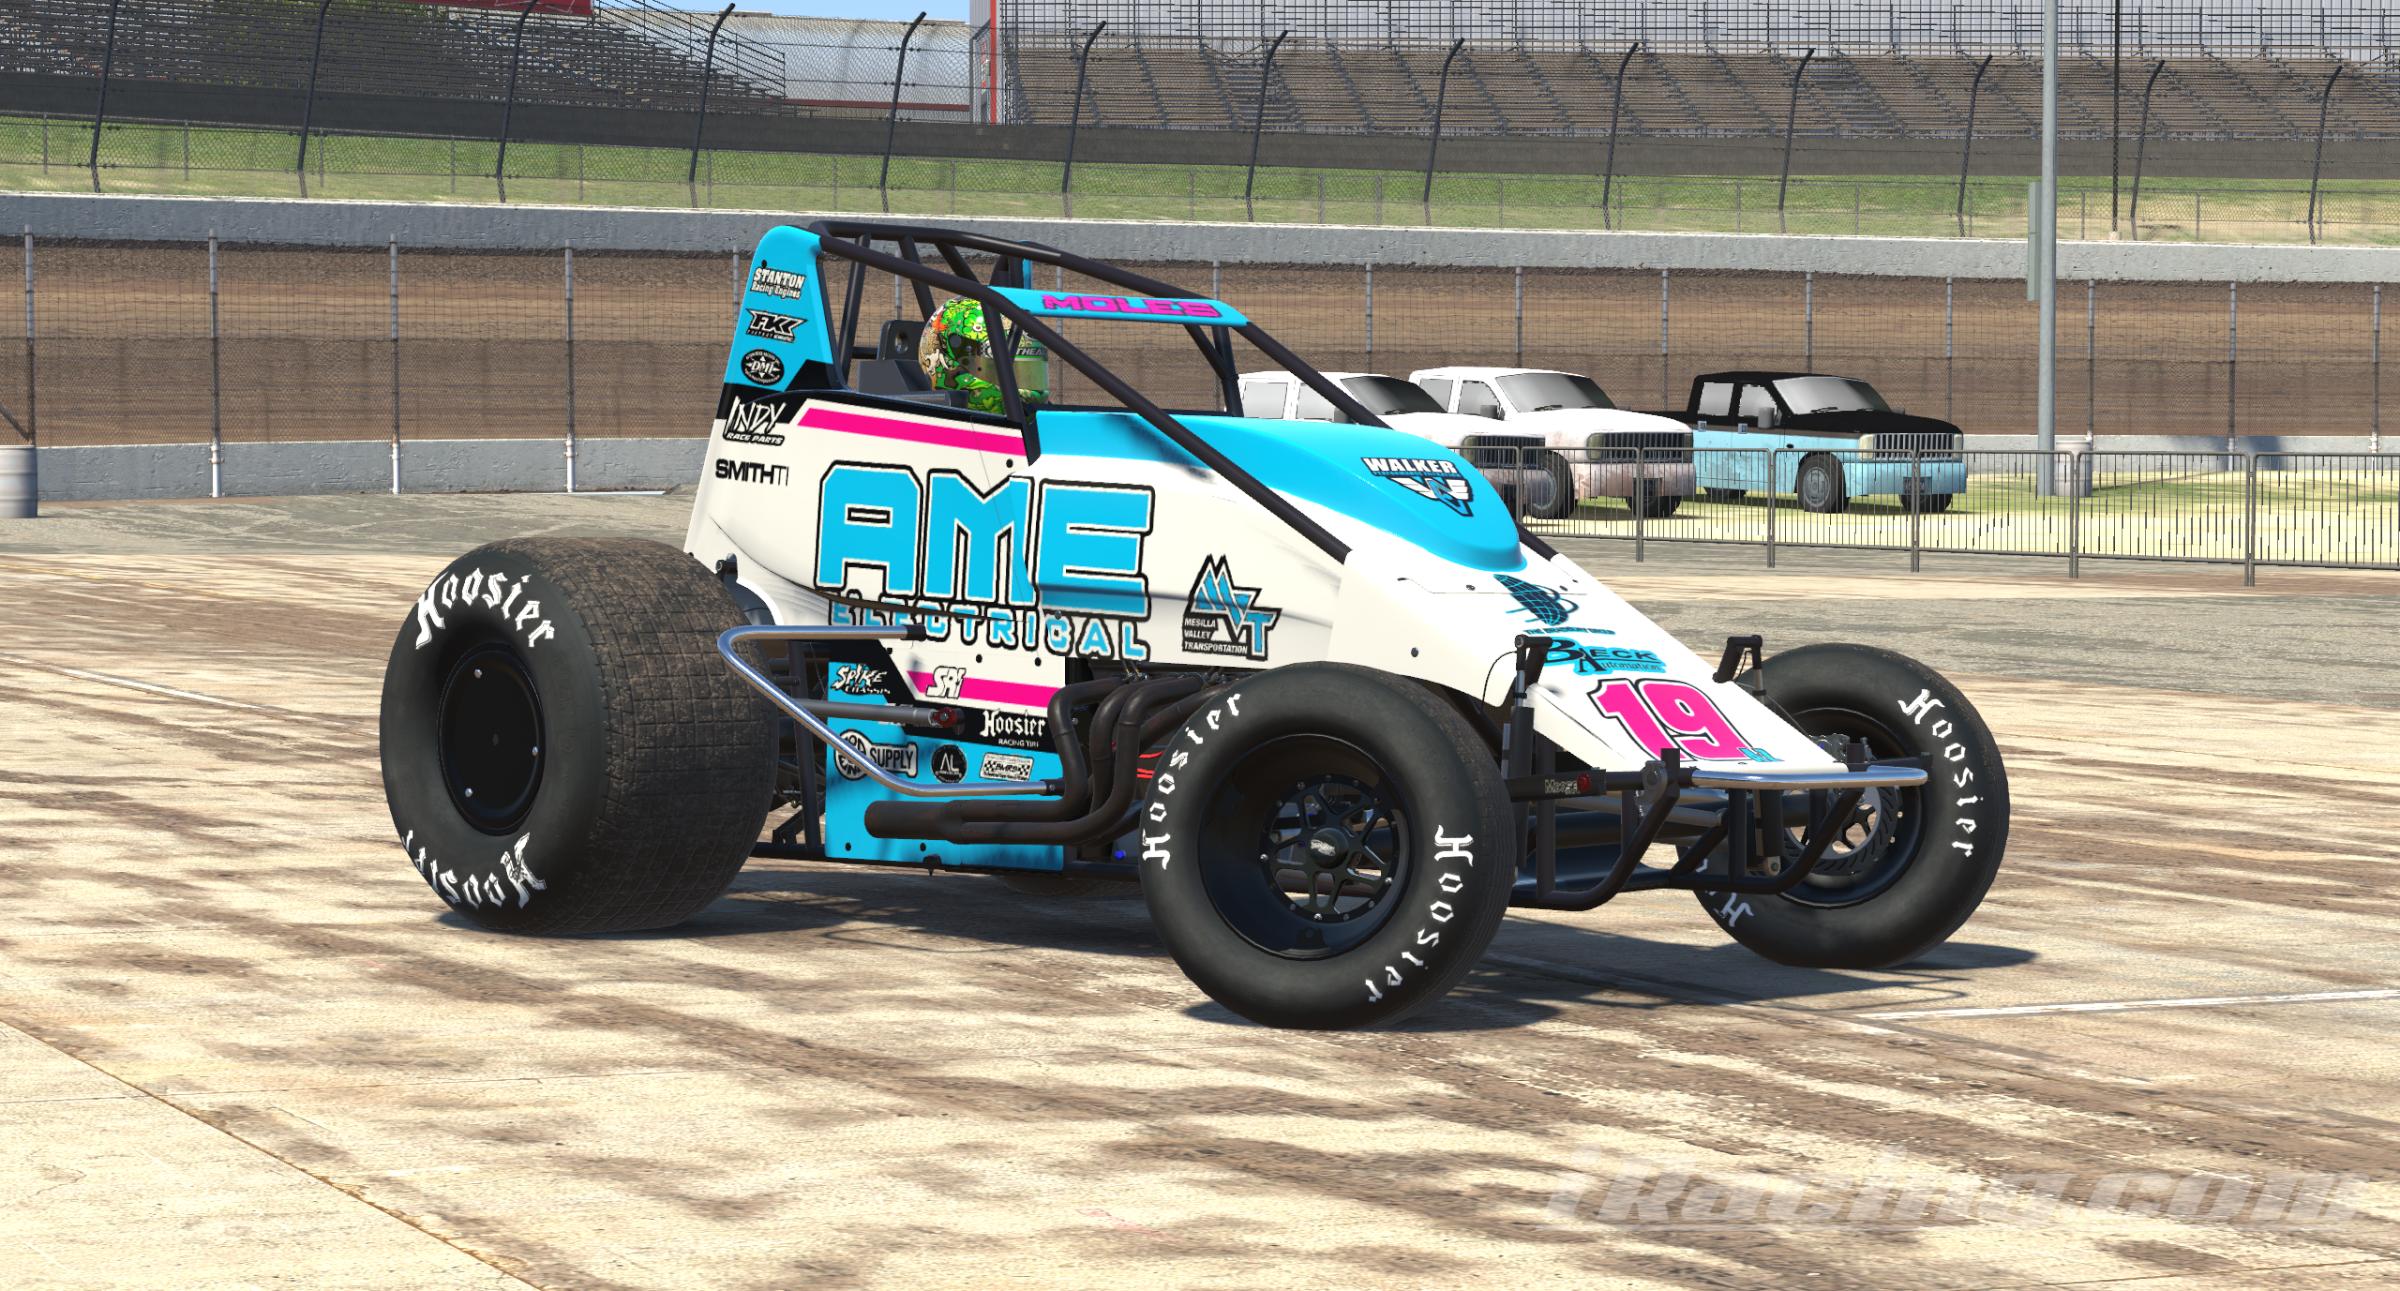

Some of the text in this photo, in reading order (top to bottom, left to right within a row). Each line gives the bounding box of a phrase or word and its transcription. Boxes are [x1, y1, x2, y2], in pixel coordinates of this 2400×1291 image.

[751, 281, 801, 299] Racing Engines
[753, 267, 805, 288] STANTON
[1041, 294, 1222, 318] MOLES
[724, 396, 787, 435] INDY
[726, 432, 784, 446] RACE PARTS
[1361, 457, 1458, 474] WALKER
[815, 460, 1155, 621] AME
[415, 568, 555, 650] Hoosier
[1184, 617, 1217, 628] MESILLA
[829, 594, 1151, 664] ELECTRICAL
[1184, 629, 1212, 639] VALLEY
[1184, 641, 1248, 654] TRANSPORTATION
[831, 663, 888, 690] SPIKE
[980, 707, 1046, 737] Hoosier
[1587, 678, 1757, 761] 19
[869, 746, 914, 770] SUPPLY
[1142, 694, 1241, 870] Hoosier
[1898, 688, 1983, 858] Hoosier
[401, 830, 547, 909] Hoosier
[1365, 825, 1474, 1003] Hoosier
